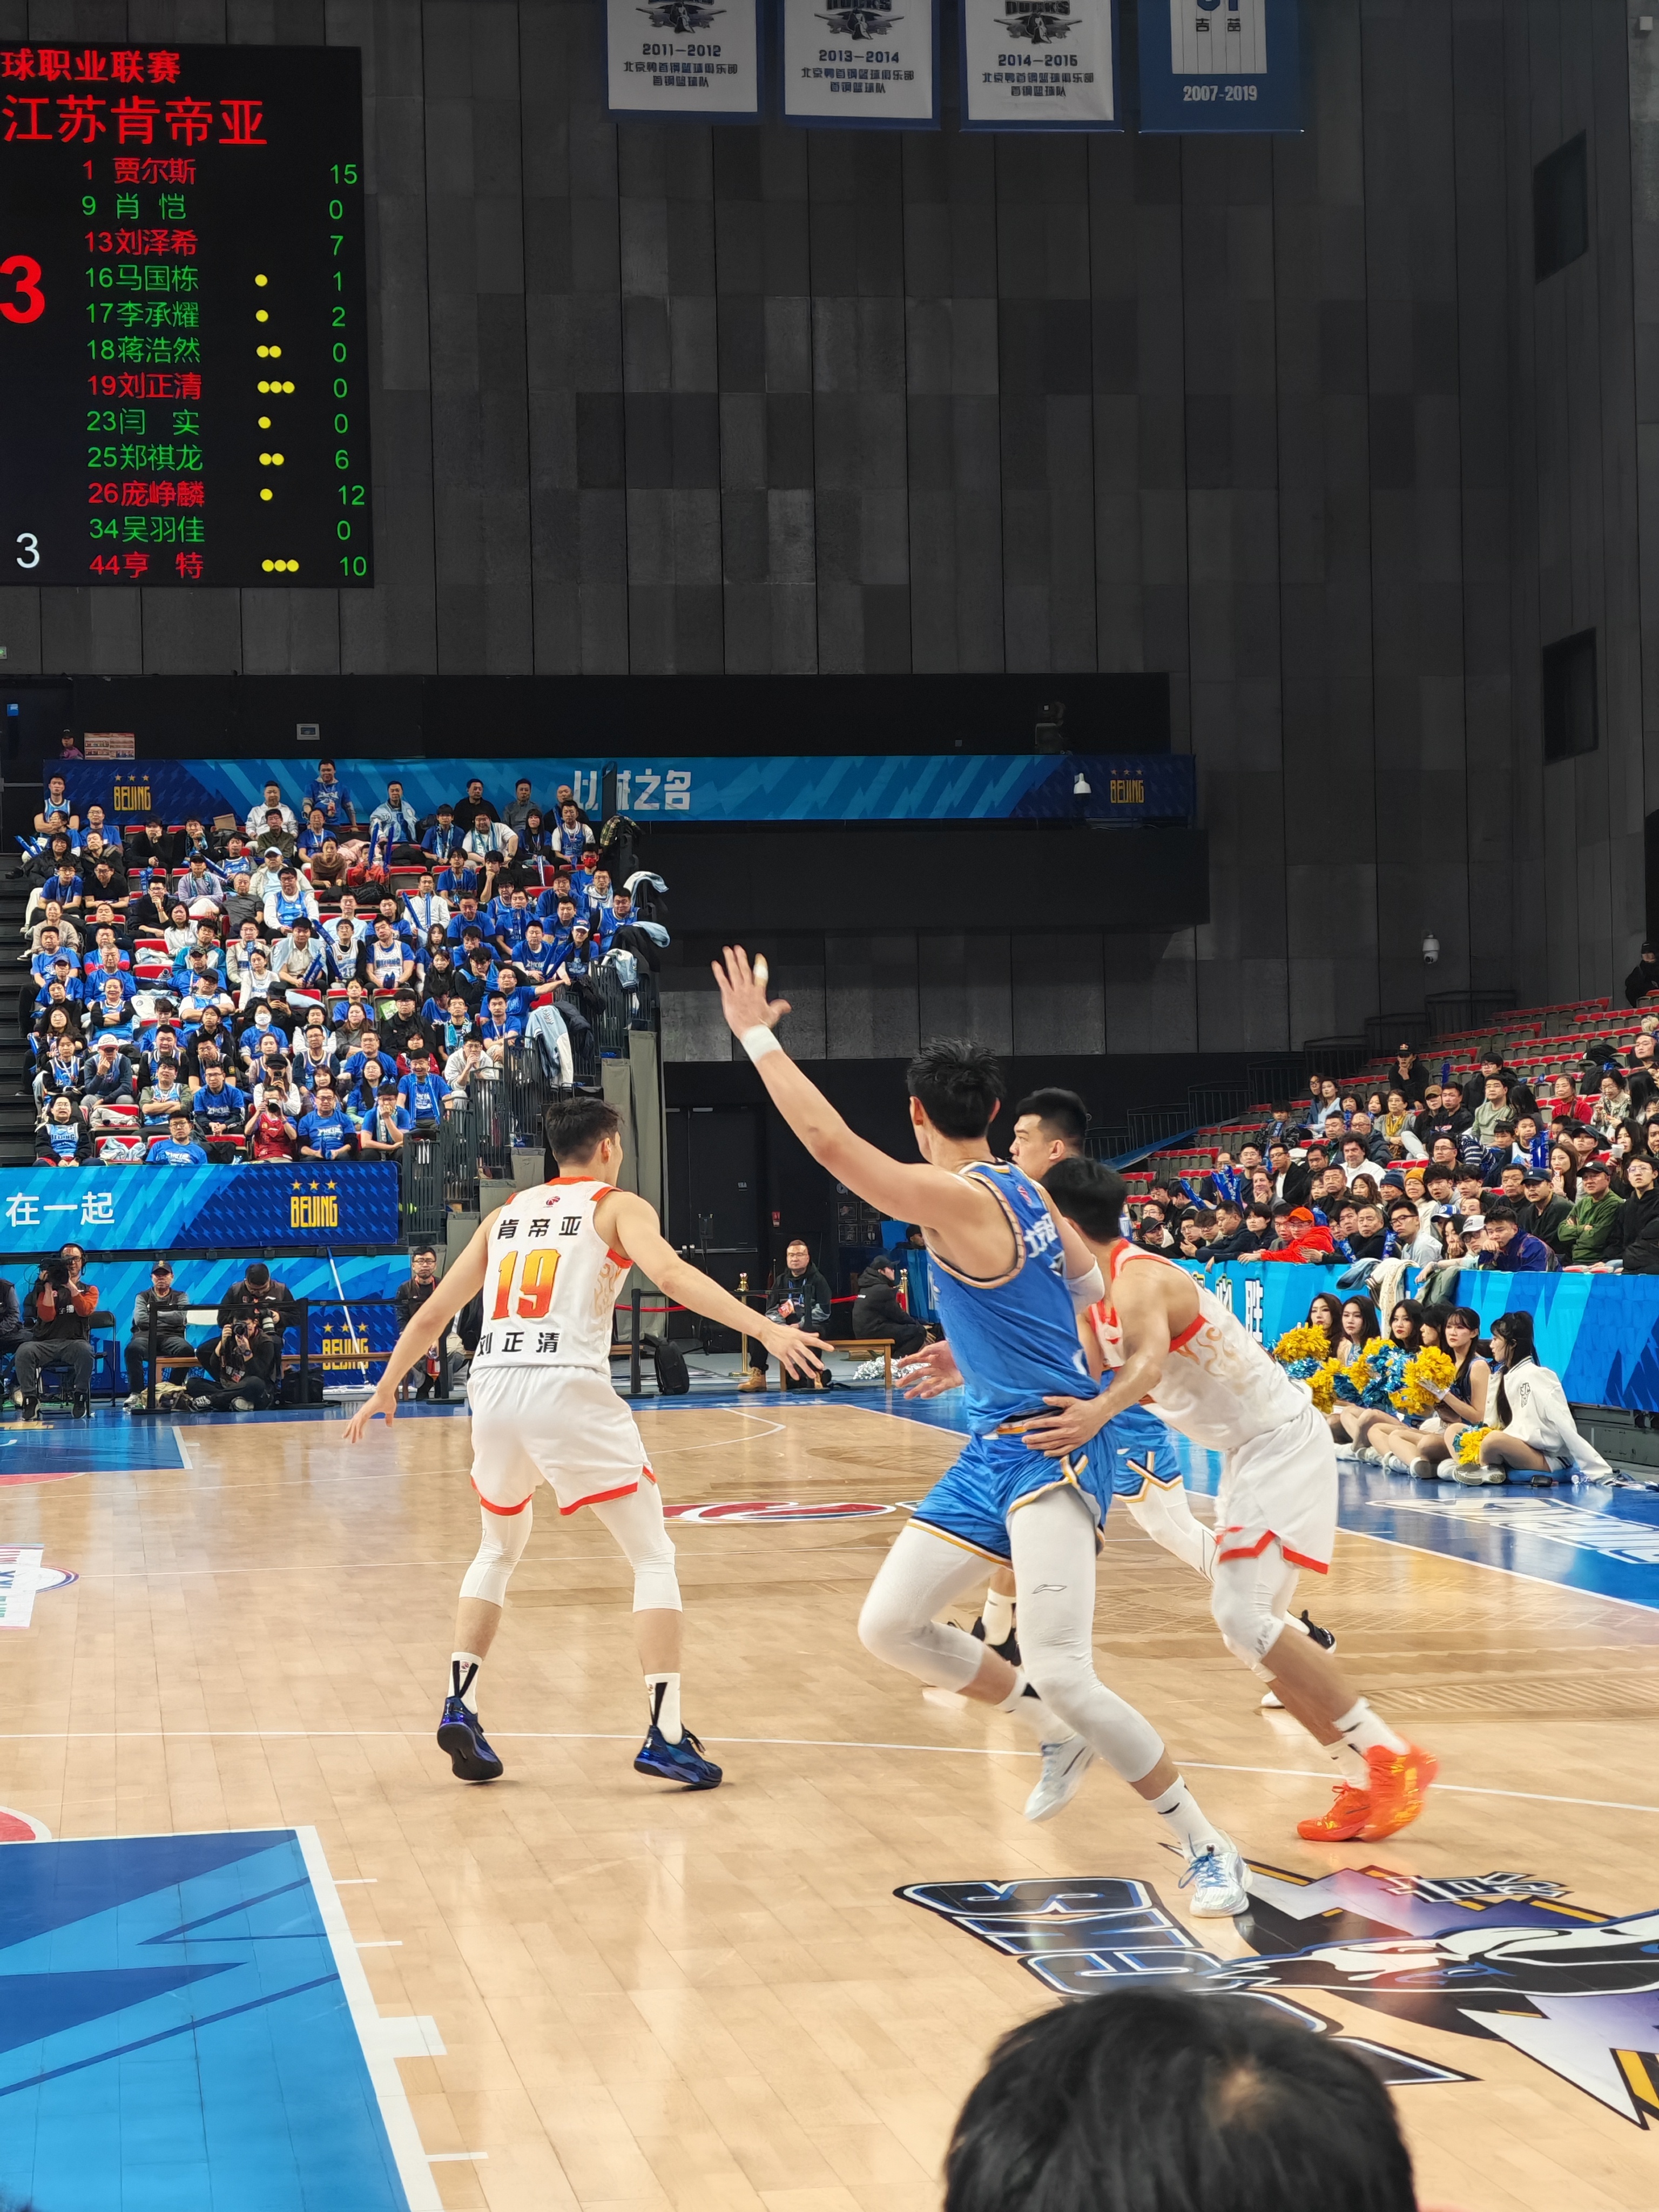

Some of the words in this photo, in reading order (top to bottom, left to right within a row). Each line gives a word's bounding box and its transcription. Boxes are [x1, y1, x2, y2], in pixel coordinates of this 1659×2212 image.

[1, 47, 181, 84] 球职业联赛
[1182, 85, 1259, 102] 2007-2019
[2, 93, 268, 147] 江苏肯帝亚
[83, 159, 93, 179] 1
[114, 157, 195, 184] 贾尔斯
[331, 164, 358, 185] 15
[82, 195, 97, 216] 9
[329, 199, 343, 220] 0
[85, 231, 113, 253] 13
[116, 228, 198, 257] 刘泽希
[331, 234, 344, 257] 7
[86, 267, 113, 289] 16
[116, 264, 199, 292] 马国栋
[333, 271, 342, 292] 1
[87, 302, 114, 323] 17
[117, 300, 200, 328] 李承耀
[332, 306, 346, 328] 2
[88, 339, 115, 361] 18
[118, 336, 201, 364] 蒋浩然
[333, 342, 347, 363] 0
[88, 375, 117, 396] 19
[118, 372, 202, 400] 刘正清
[333, 377, 348, 399] 0
[87, 410, 117, 431] 23
[334, 413, 349, 434] 0
[87, 446, 118, 468] 25
[335, 449, 350, 470] 6
[89, 482, 119, 504] 26
[338, 484, 366, 506] 12
[90, 518, 119, 539] 34
[122, 516, 205, 543] 吴羽佳
[336, 520, 352, 541] 0
[16, 532, 40, 569] 3
[89, 554, 120, 575] 44
[340, 556, 368, 577] 10
[113, 786, 151, 811] BEIJING
[1110, 779, 1144, 804] BEIJING
[5, 1191, 116, 1228] 在一起
[291, 1195, 338, 1228] BEIJING
[497, 1216, 583, 1240] 肯帝亚
[491, 1249, 561, 1321] 19
[477, 1331, 561, 1357] 刘正清
